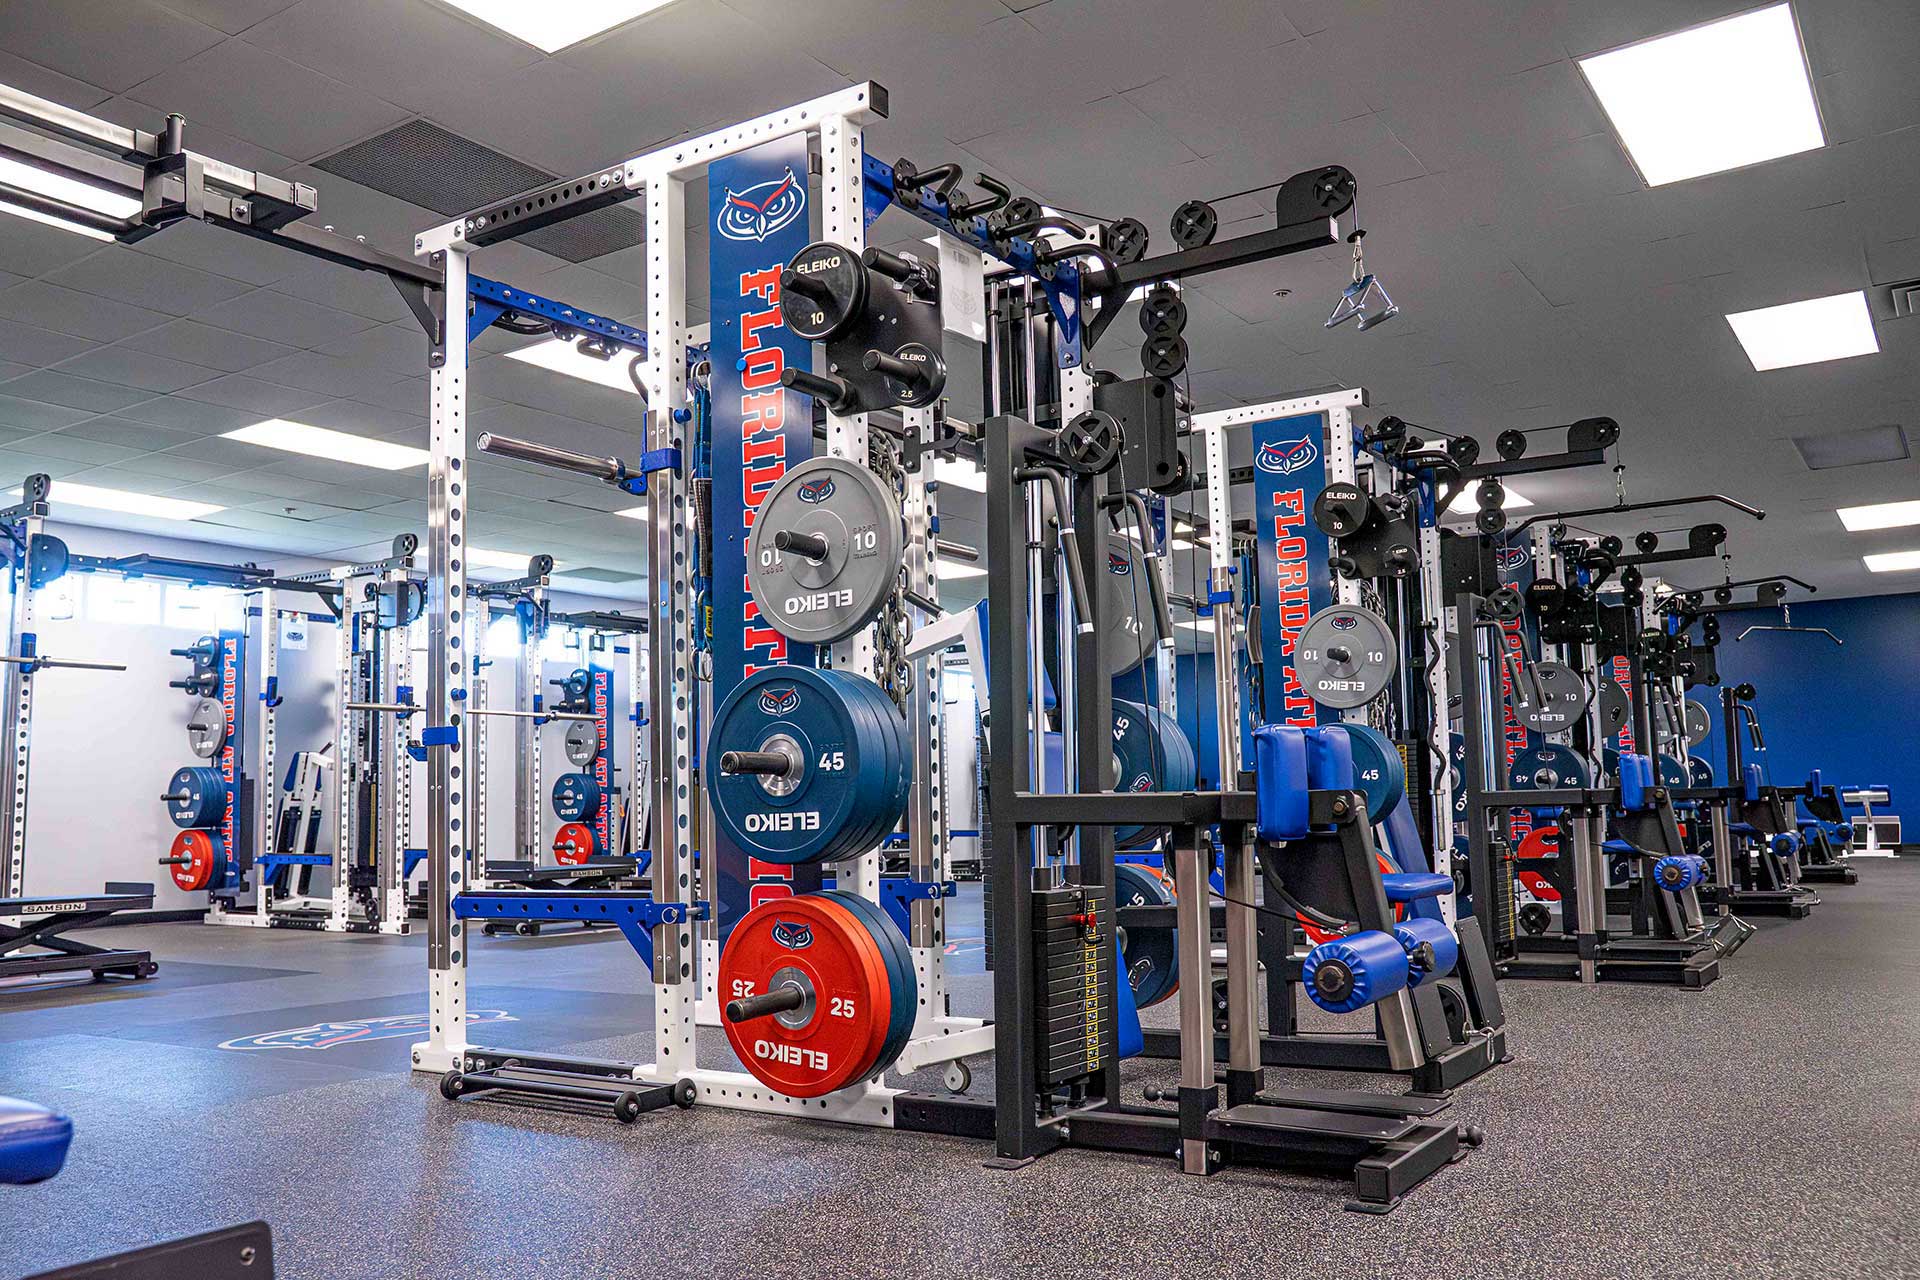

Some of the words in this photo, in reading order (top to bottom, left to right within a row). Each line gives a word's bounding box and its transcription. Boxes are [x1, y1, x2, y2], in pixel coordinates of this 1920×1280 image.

[796, 256, 841, 274] ELEIKO
[810, 312, 824, 326] 10
[900, 352, 926, 362] ELEIKO
[901, 390, 913, 398] 2.5
[740, 263, 787, 556] FLORID
[1326, 492, 1357, 500] ELEIKO
[1333, 522, 1343, 530] 10
[854, 531, 876, 550] 10
[761, 549, 782, 567] 10
[1273, 488, 1310, 656] FLORIDA
[785, 588, 853, 614] ELEIKO
[1124, 616, 1143, 634] 10
[1303, 650, 1319, 661] 10
[1368, 651, 1384, 663] 10
[223, 638, 236, 736] FLORIDA
[1318, 680, 1366, 691] ELEIKO
[1112, 716, 1130, 742] 45
[819, 752, 845, 772] 45
[1362, 769, 1380, 780] 45
[1516, 775, 1528, 783] 45
[1564, 777, 1578, 785] 45
[1698, 772, 1708, 780] 45
[745, 811, 820, 832] ELEIKO
[27, 904, 81, 912] SAMSON
[732, 979, 755, 998] 25
[830, 997, 855, 1019] 25
[754, 1040, 828, 1070] ELEIKO
